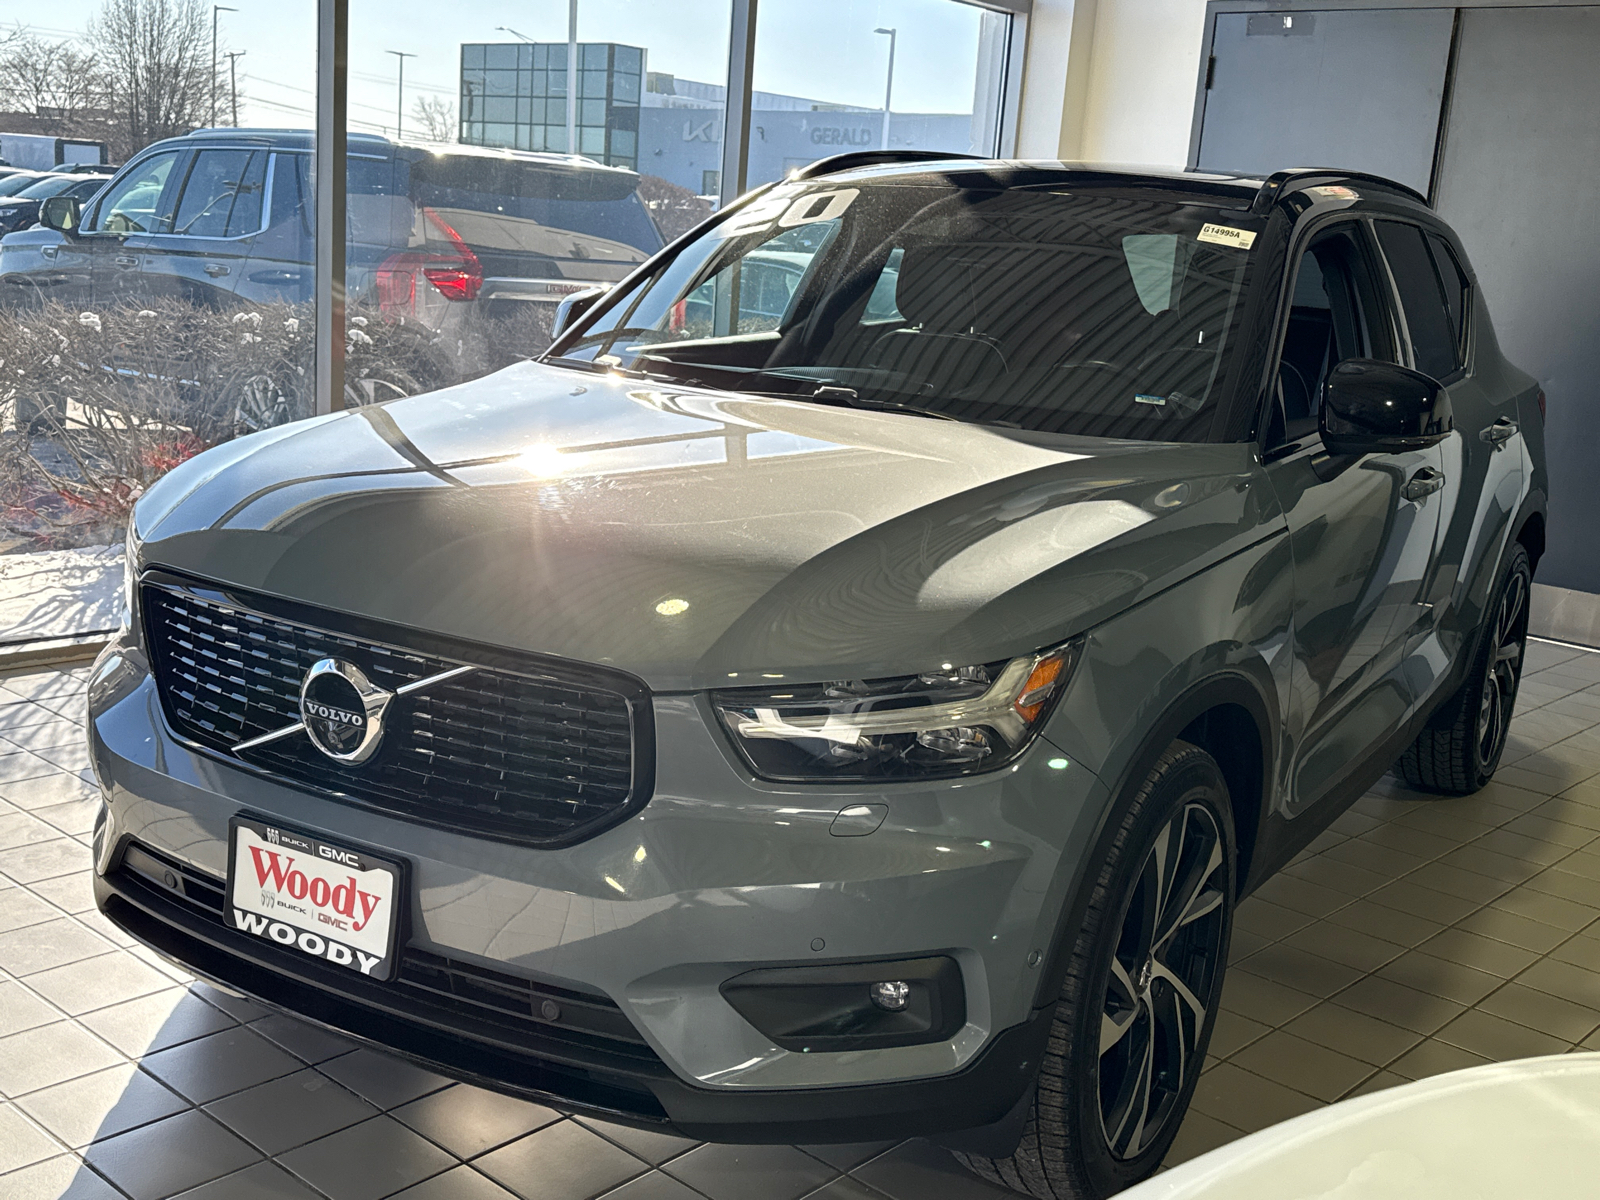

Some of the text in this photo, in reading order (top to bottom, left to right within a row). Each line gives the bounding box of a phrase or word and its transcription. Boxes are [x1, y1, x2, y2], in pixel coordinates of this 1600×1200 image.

[682, 119, 722, 143] KI
[810, 126, 872, 146] GERALD
[1203, 225, 1241, 239] G14995A
[550, 284, 591, 295] GM
[306, 702, 363, 726] VOLVO
[281, 836, 360, 867] BUICK GMC
[248, 845, 382, 932] Woody
[276, 900, 349, 932] BUICK GMC
[233, 908, 381, 976] WOODY
